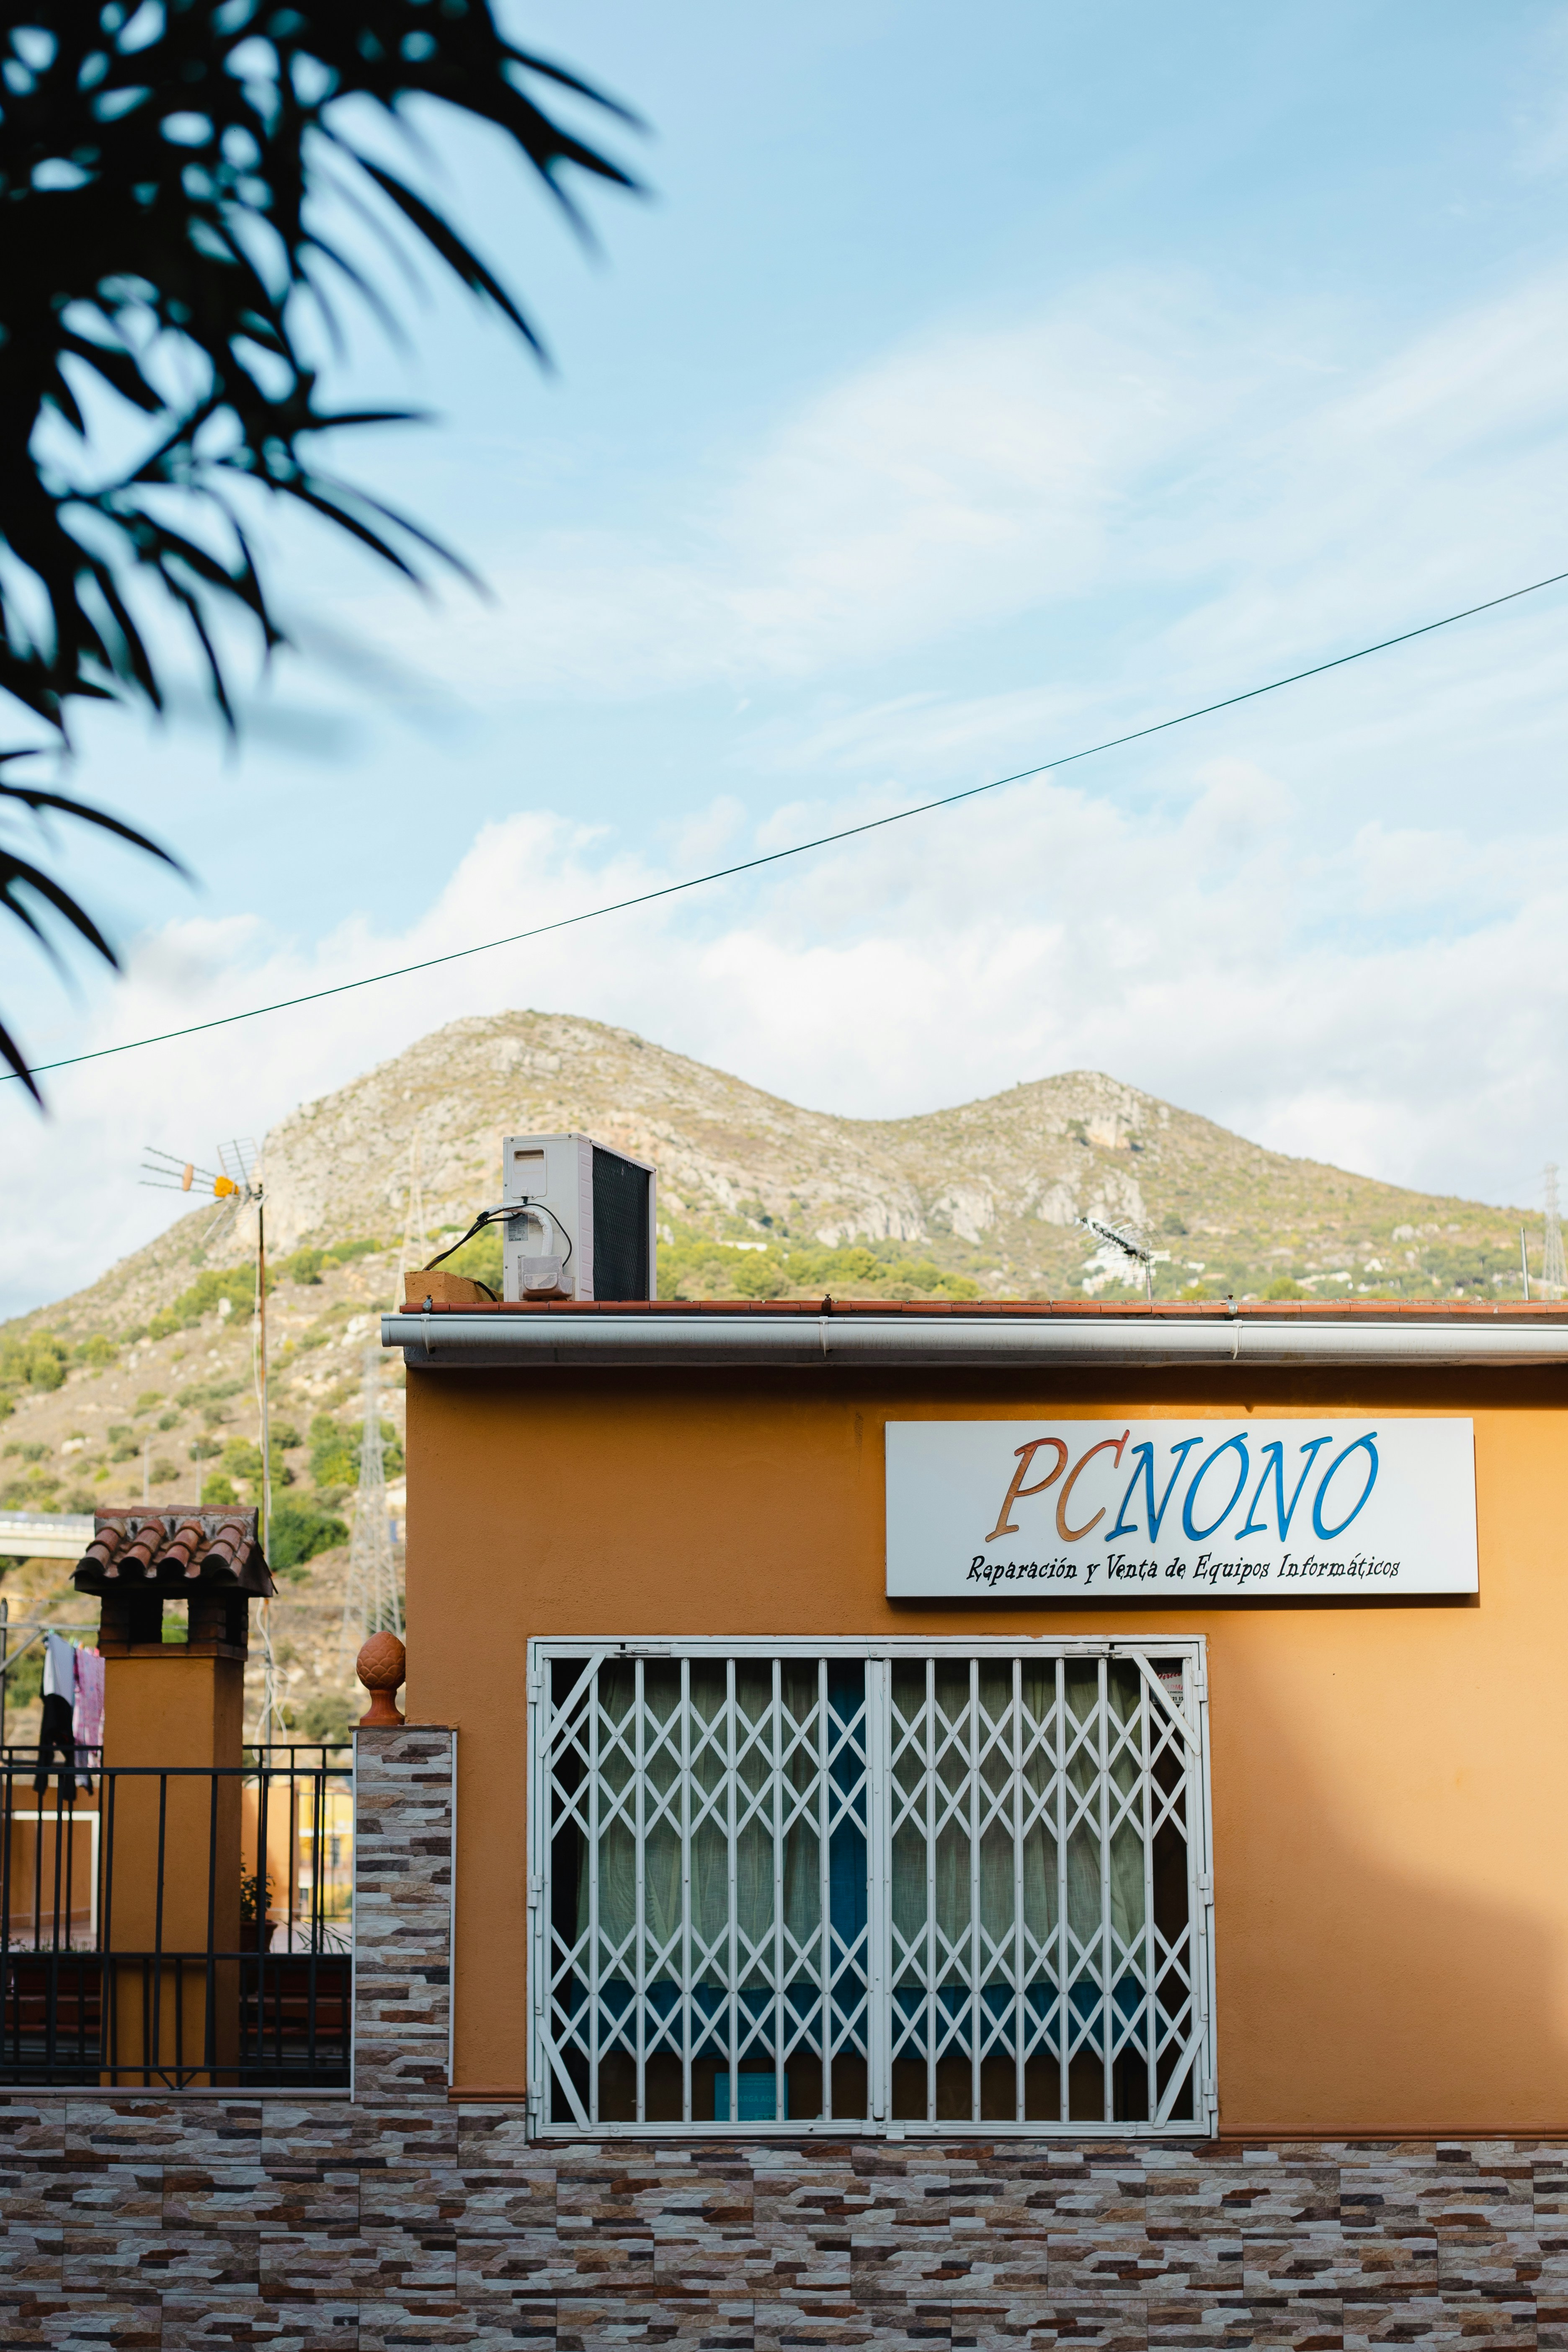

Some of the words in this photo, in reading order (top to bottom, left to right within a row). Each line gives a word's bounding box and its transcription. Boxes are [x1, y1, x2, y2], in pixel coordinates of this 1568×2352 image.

[985, 1429, 1380, 1544] PCNONO
[966, 1555, 1078, 1587] Reparación
[1084, 1563, 1101, 1585] y
[1107, 1554, 1158, 1581] Venta
[1165, 1557, 1186, 1580] de
[1192, 1552, 1271, 1585] Equipos
[1277, 1553, 1401, 1579] Informáticos
